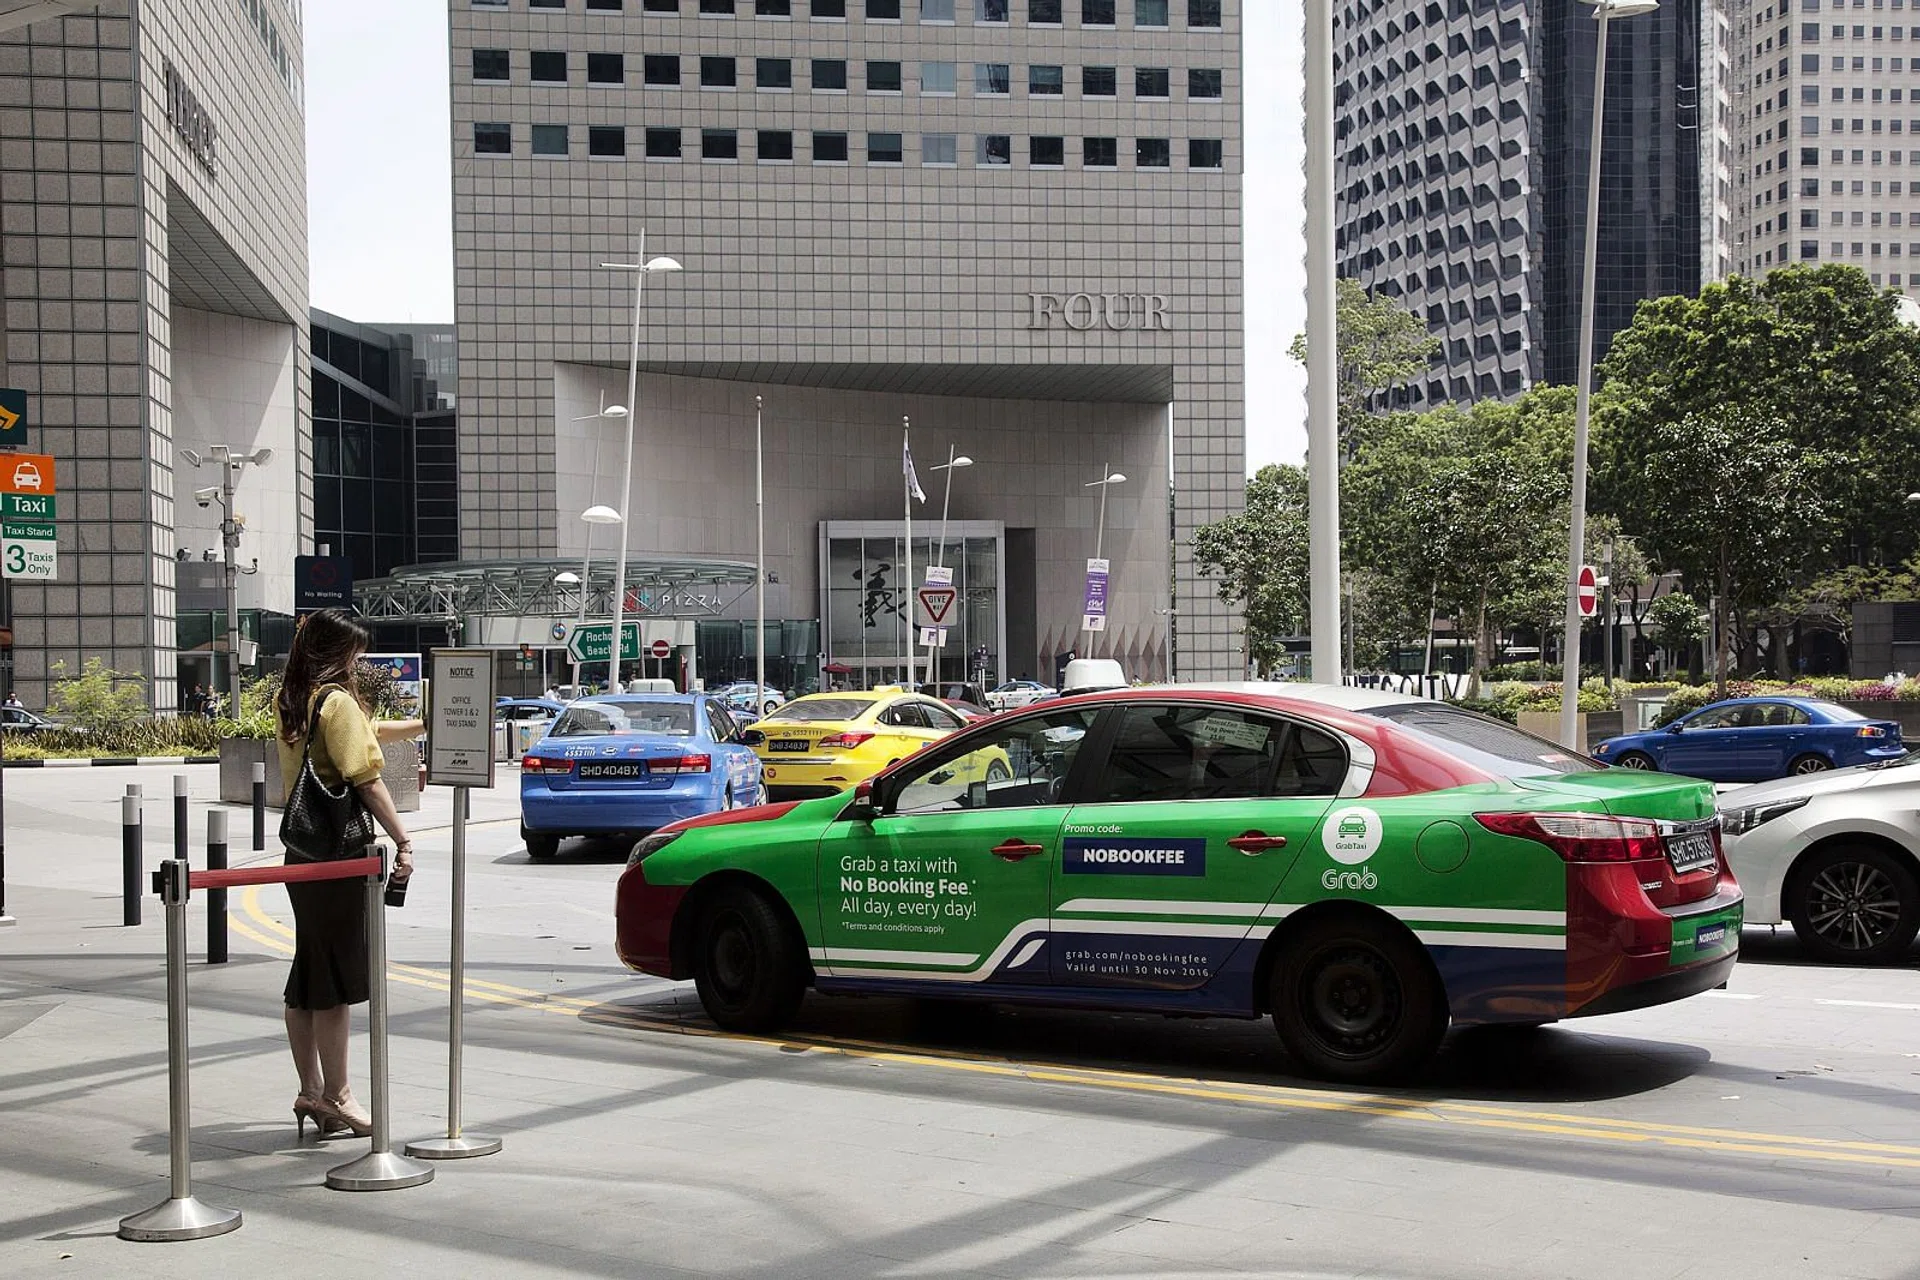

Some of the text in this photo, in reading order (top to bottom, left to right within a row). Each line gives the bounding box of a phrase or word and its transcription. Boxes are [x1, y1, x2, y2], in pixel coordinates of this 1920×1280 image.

[1028, 292, 1172, 331] FOUR
[12, 496, 46, 513] Taxi
[5, 525, 53, 537] Taxi Stand
[6, 544, 26, 573] 3
[27, 551, 53, 562] Taxis
[28, 563, 51, 576] Only
[317, 591, 342, 599] Waiting
[662, 595, 722, 606] PIZZA
[928, 595, 946, 604] GIVE
[586, 630, 632, 642] Rocho Rd
[450, 667, 474, 676] NOTICE
[452, 696, 471, 704] OFFICE
[443, 707, 463, 716] TOWER
[446, 719, 477, 728] TAXI STAND
[580, 765, 639, 776] SHD4048X
[1065, 824, 1123, 833] Promo code:
[1335, 842, 1367, 850] GrabTaxi
[1083, 848, 1185, 864] NOBOOKFEE
[841, 855, 957, 873] Grab a taxi with
[1321, 865, 1378, 889] Grab
[840, 876, 863, 893] No
[867, 877, 934, 898] Booking
[841, 897, 977, 920] All day, every day!
[868, 922, 882, 931] and
[884, 923, 922, 932] conditions
[924, 924, 945, 934] apply
[1065, 950, 1208, 964] grab.com/nobookingfee
[1066, 962, 1214, 977] Valid until 30 Nov 2016.
